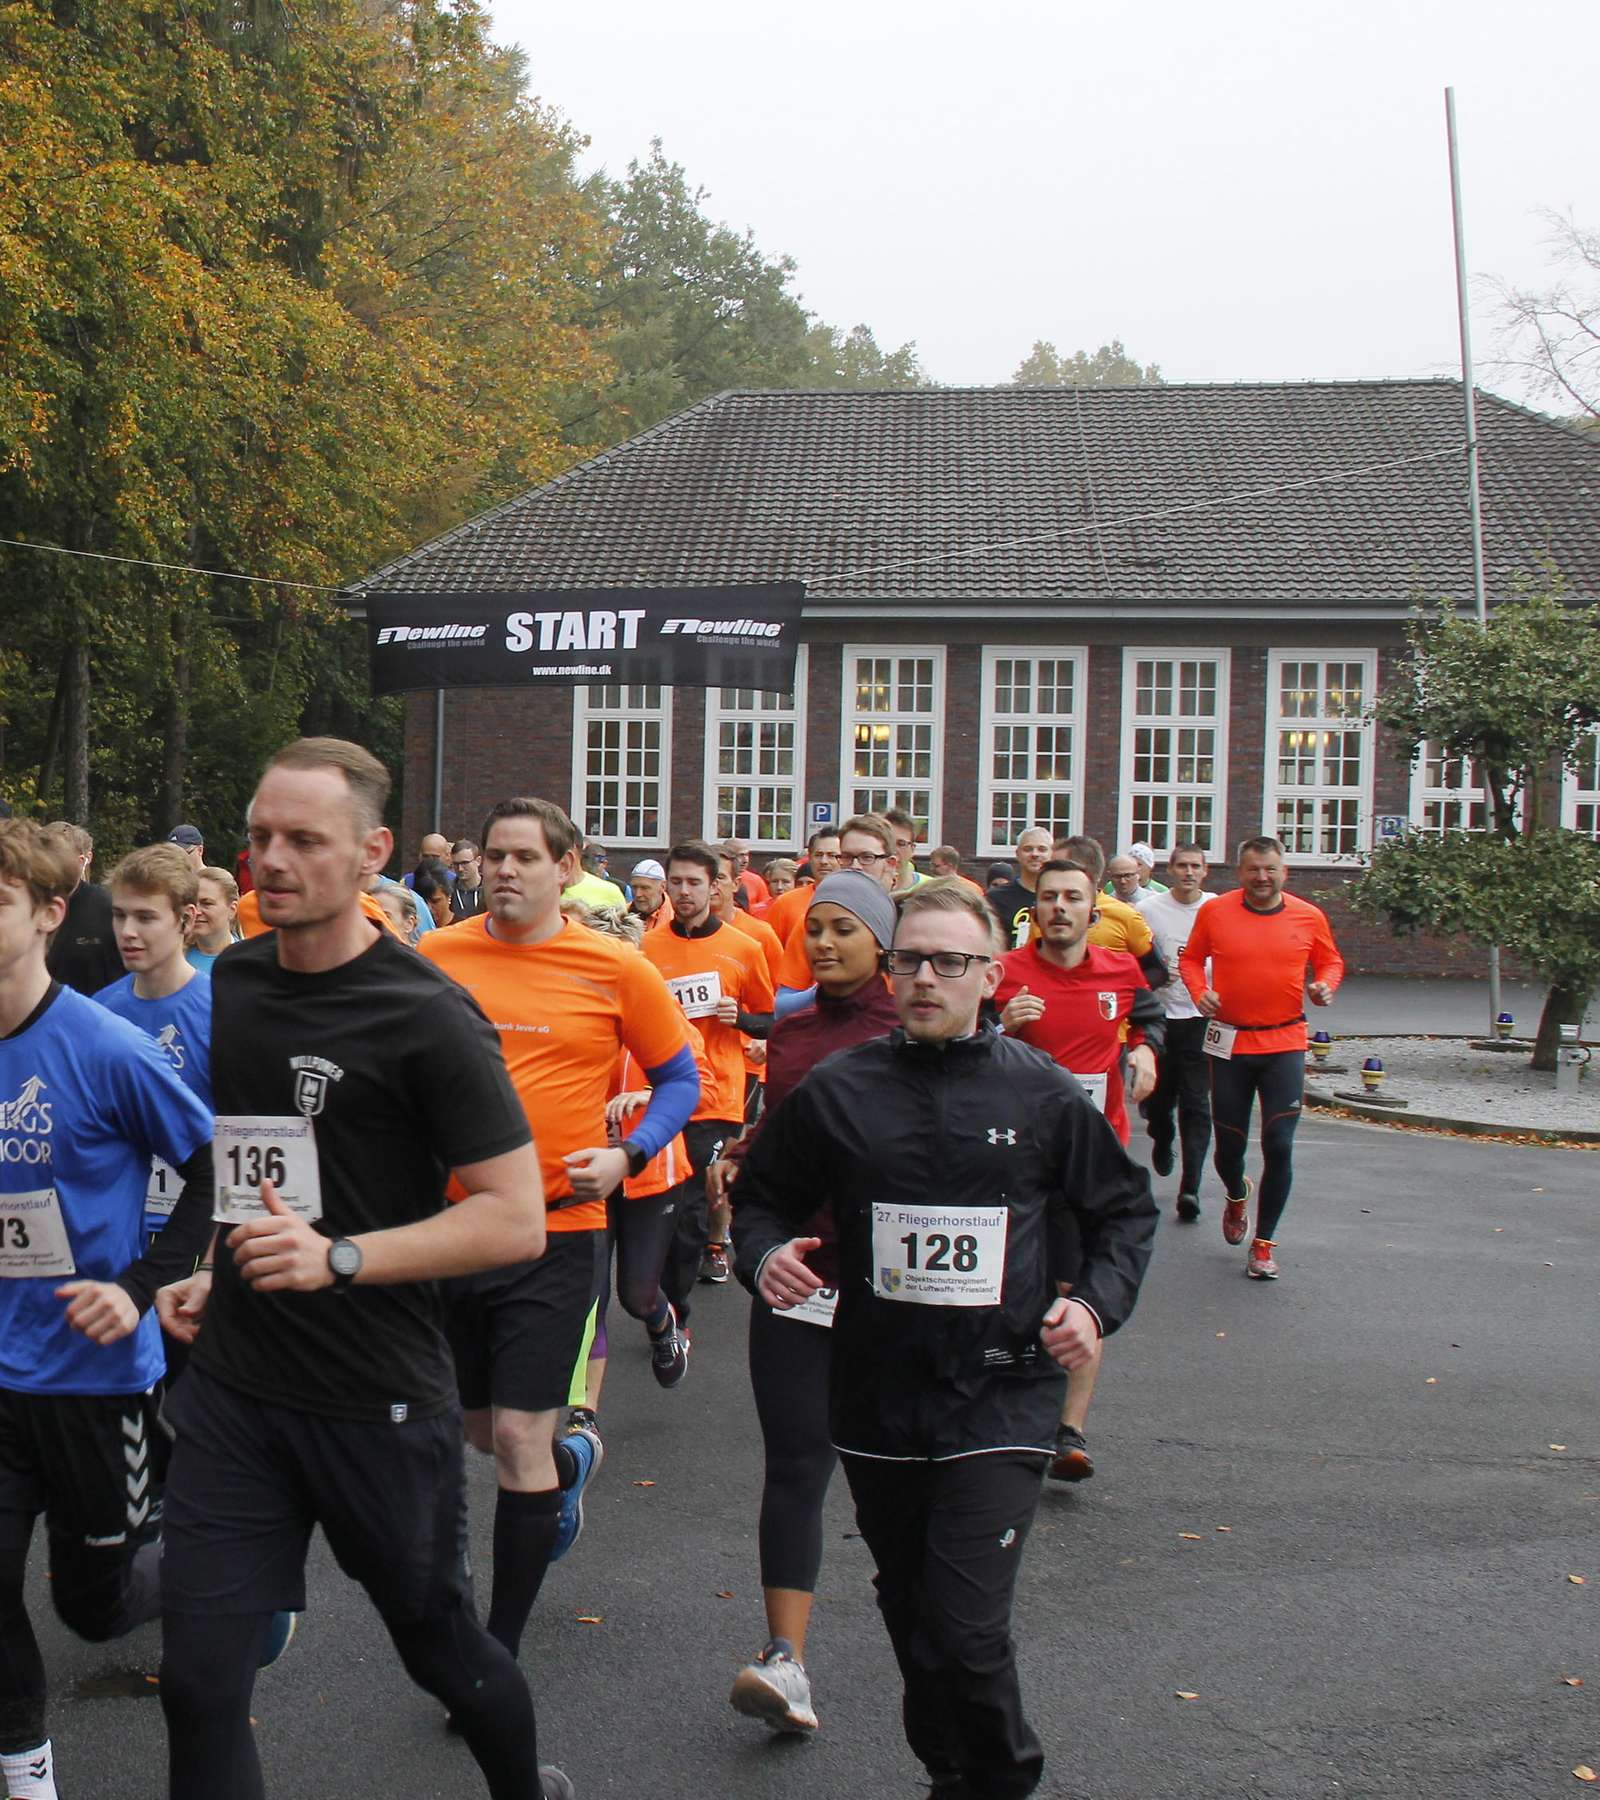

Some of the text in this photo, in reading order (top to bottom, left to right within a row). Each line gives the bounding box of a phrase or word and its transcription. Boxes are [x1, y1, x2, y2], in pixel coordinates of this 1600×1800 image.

[377, 623, 488, 645] newline
[505, 609, 646, 652] START
[660, 618, 782, 637] newline
[532, 664, 612, 676] www.newline.dk
[816, 805, 828, 820] P
[675, 985, 709, 1005] 118
[227, 1145, 285, 1188] 136
[877, 1211, 1000, 1227] 27. Fliegerhorstlauf
[900, 1232, 978, 1272] 128
